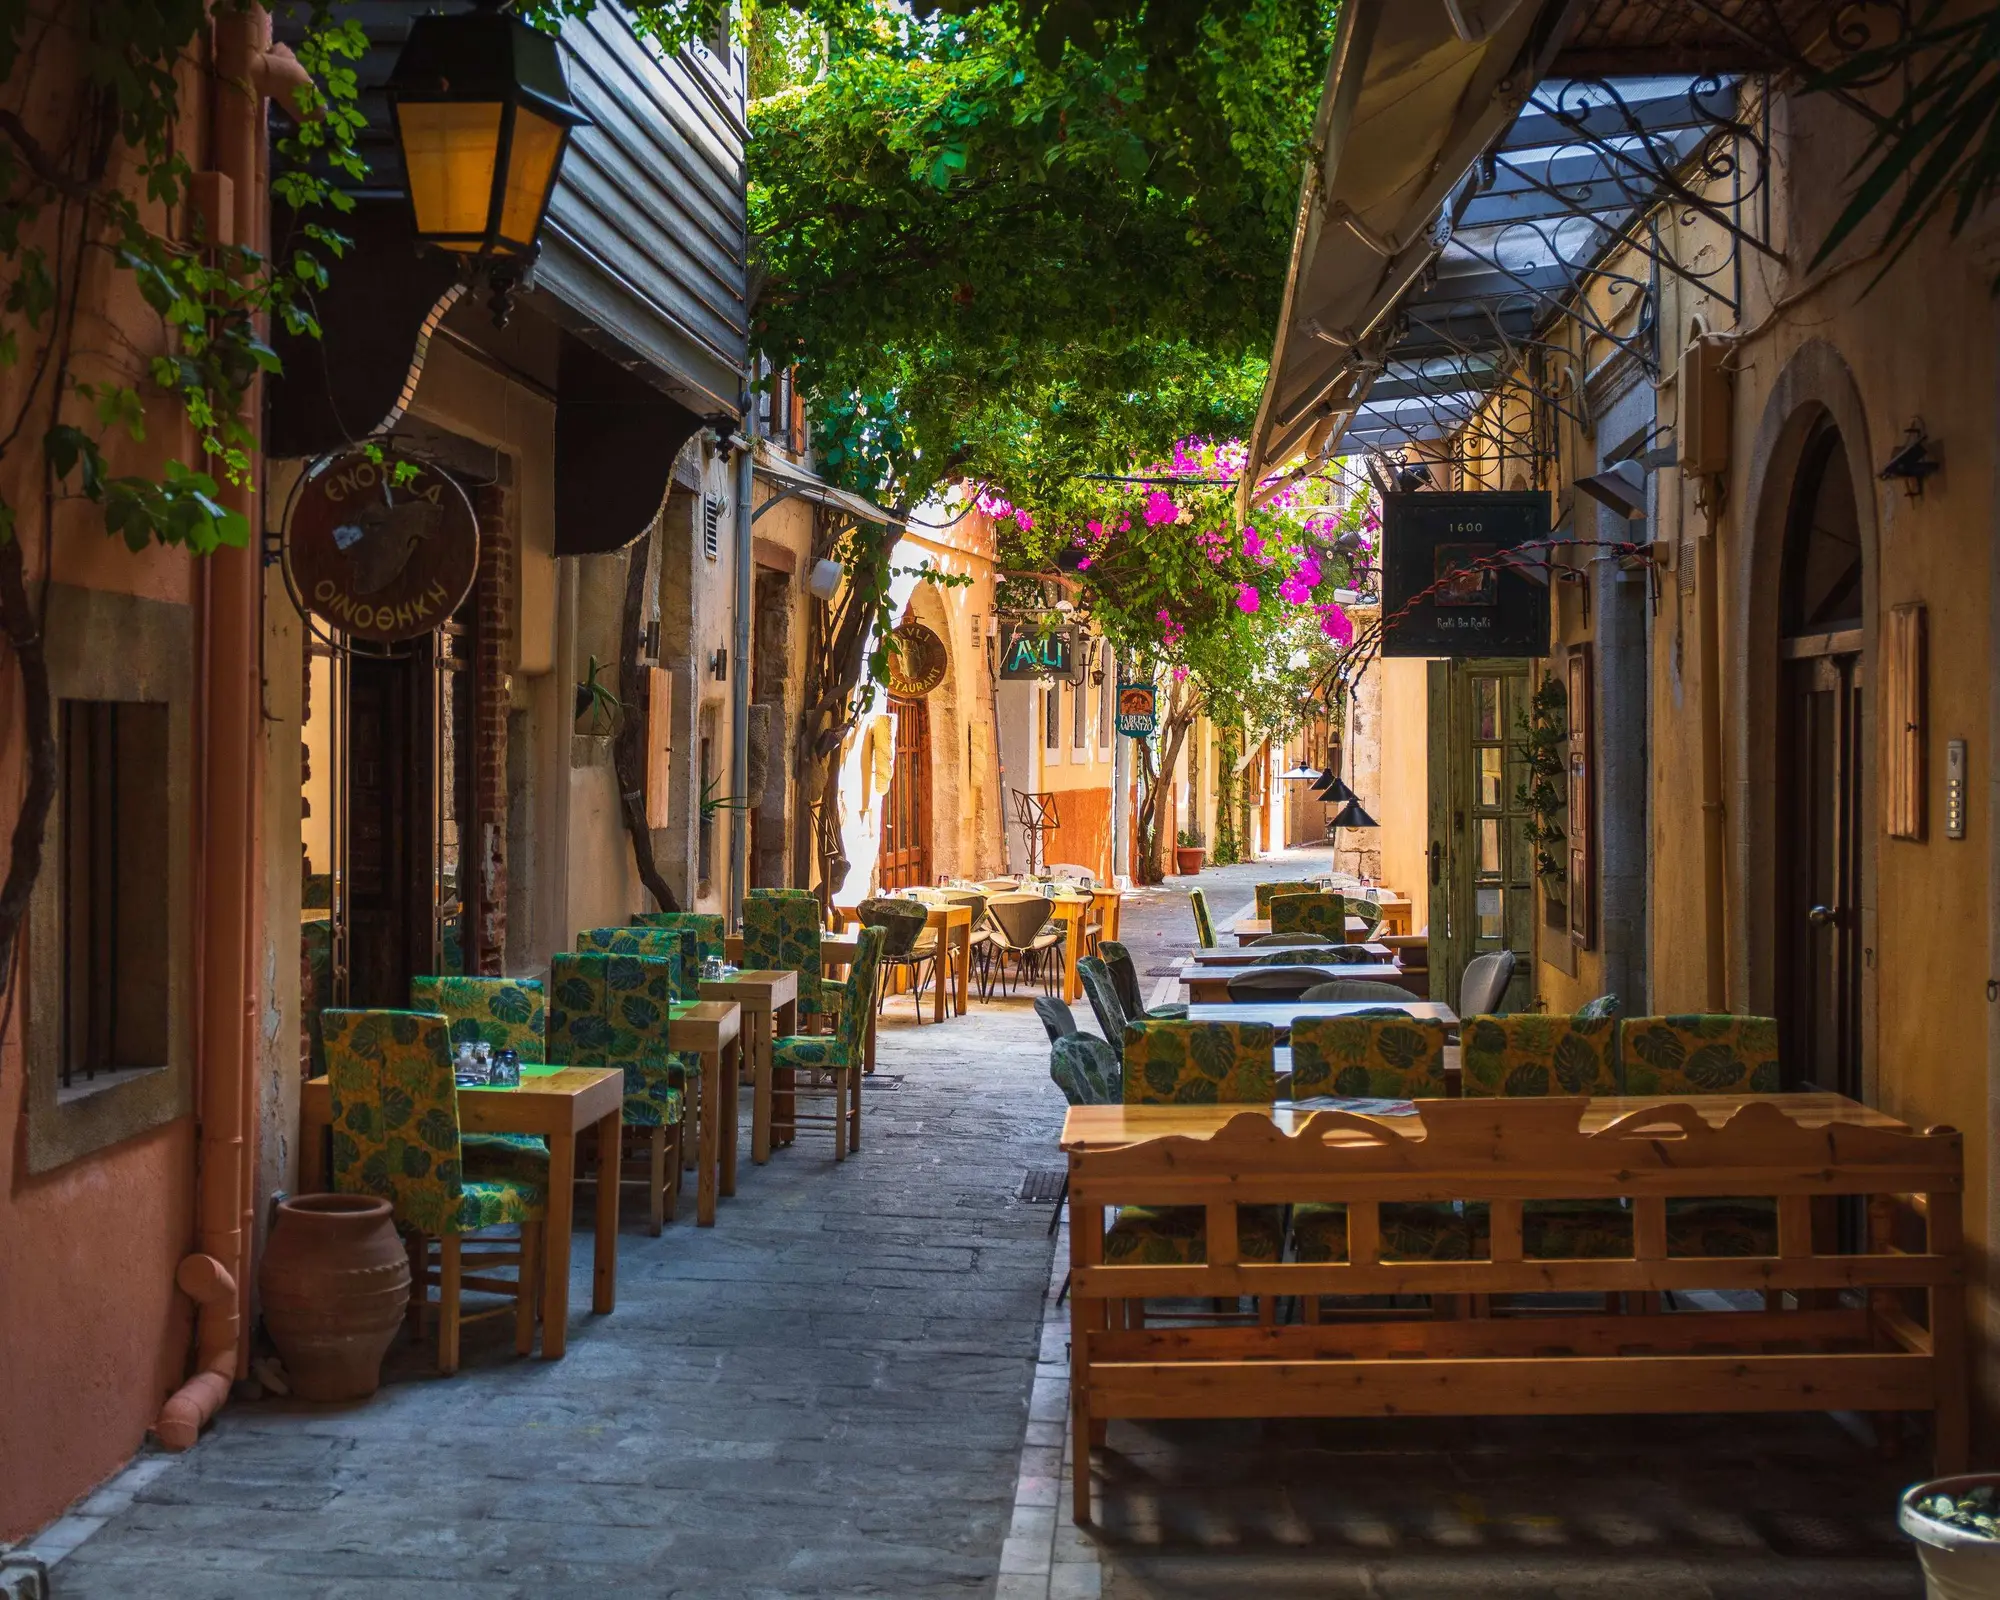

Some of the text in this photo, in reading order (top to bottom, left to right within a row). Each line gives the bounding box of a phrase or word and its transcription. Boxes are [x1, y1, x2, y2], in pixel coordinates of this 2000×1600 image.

[324, 461, 443, 506] ENOTCA
[1449, 523, 1483, 533] 1600
[314, 577, 449, 631] ΟΙΝΟΘΗΚΗ
[1009, 639, 1062, 671] AVLI
[888, 665, 941, 693] STAURANT
